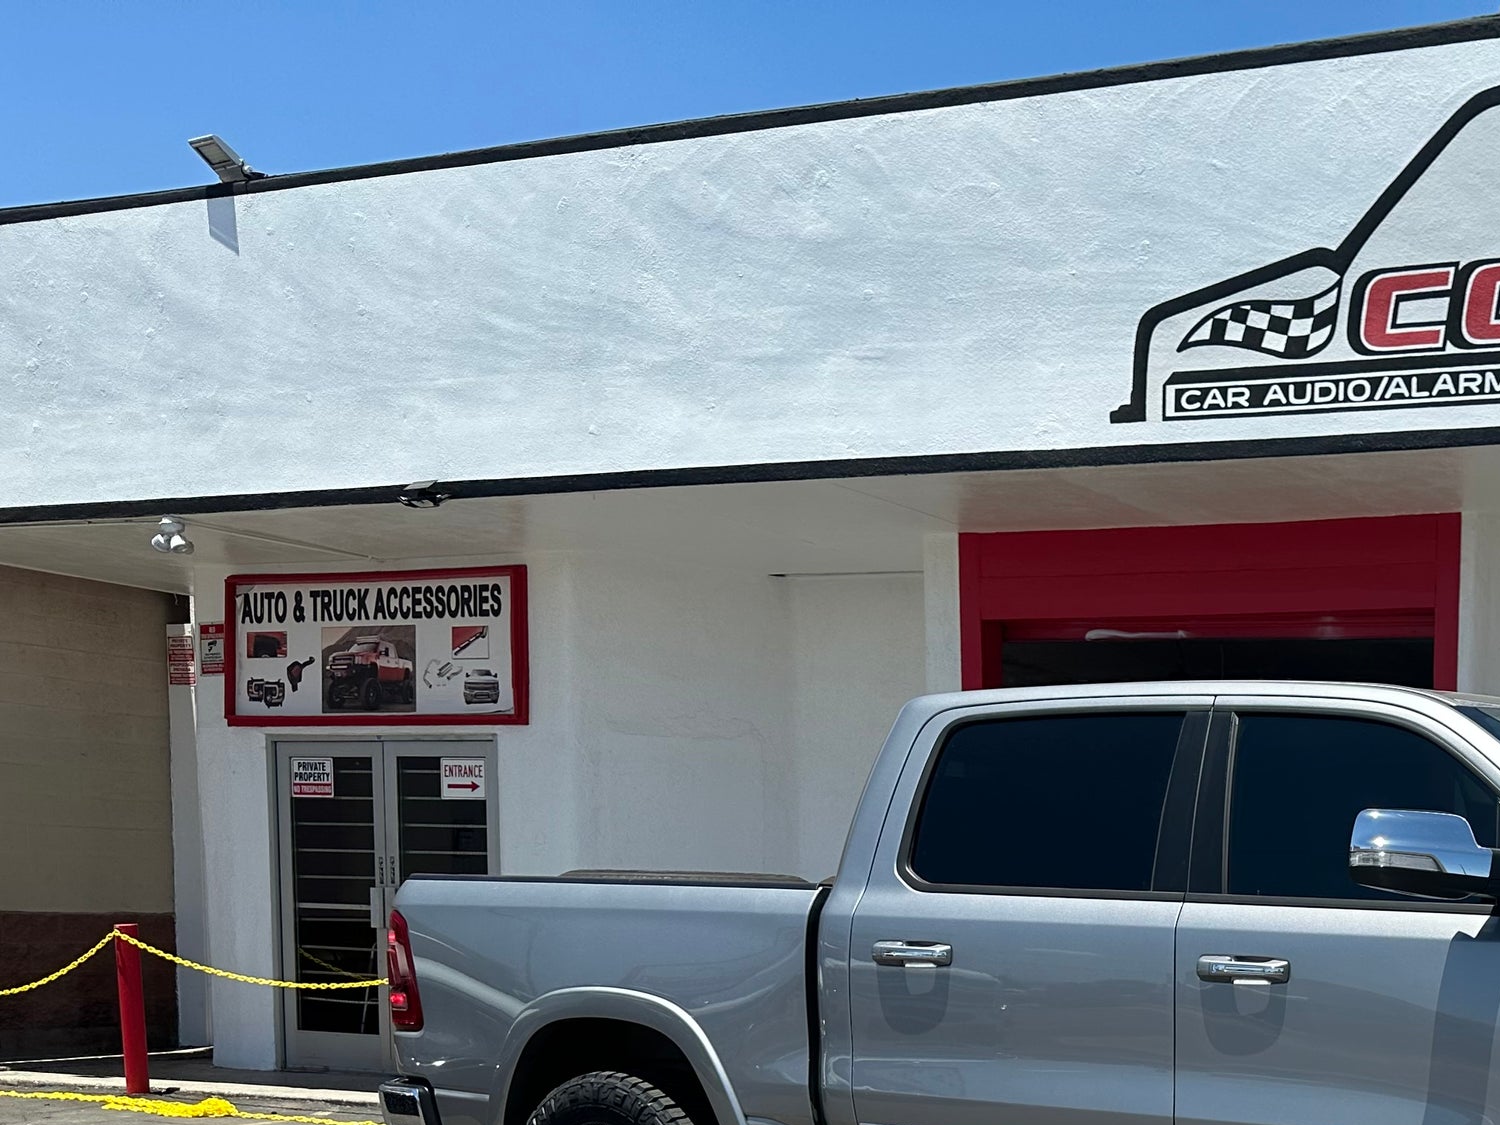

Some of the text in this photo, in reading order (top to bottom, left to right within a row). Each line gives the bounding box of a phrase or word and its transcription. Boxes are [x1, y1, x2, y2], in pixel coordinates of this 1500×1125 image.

[1180, 388, 1250, 411] CAR
[241, 583, 502, 624] AUTO & TRUCK ACCESSORIES
[297, 761, 327, 771] PRIVATE
[444, 764, 483, 778] ENTRANCE
[294, 772, 330, 782] PROPERTY
